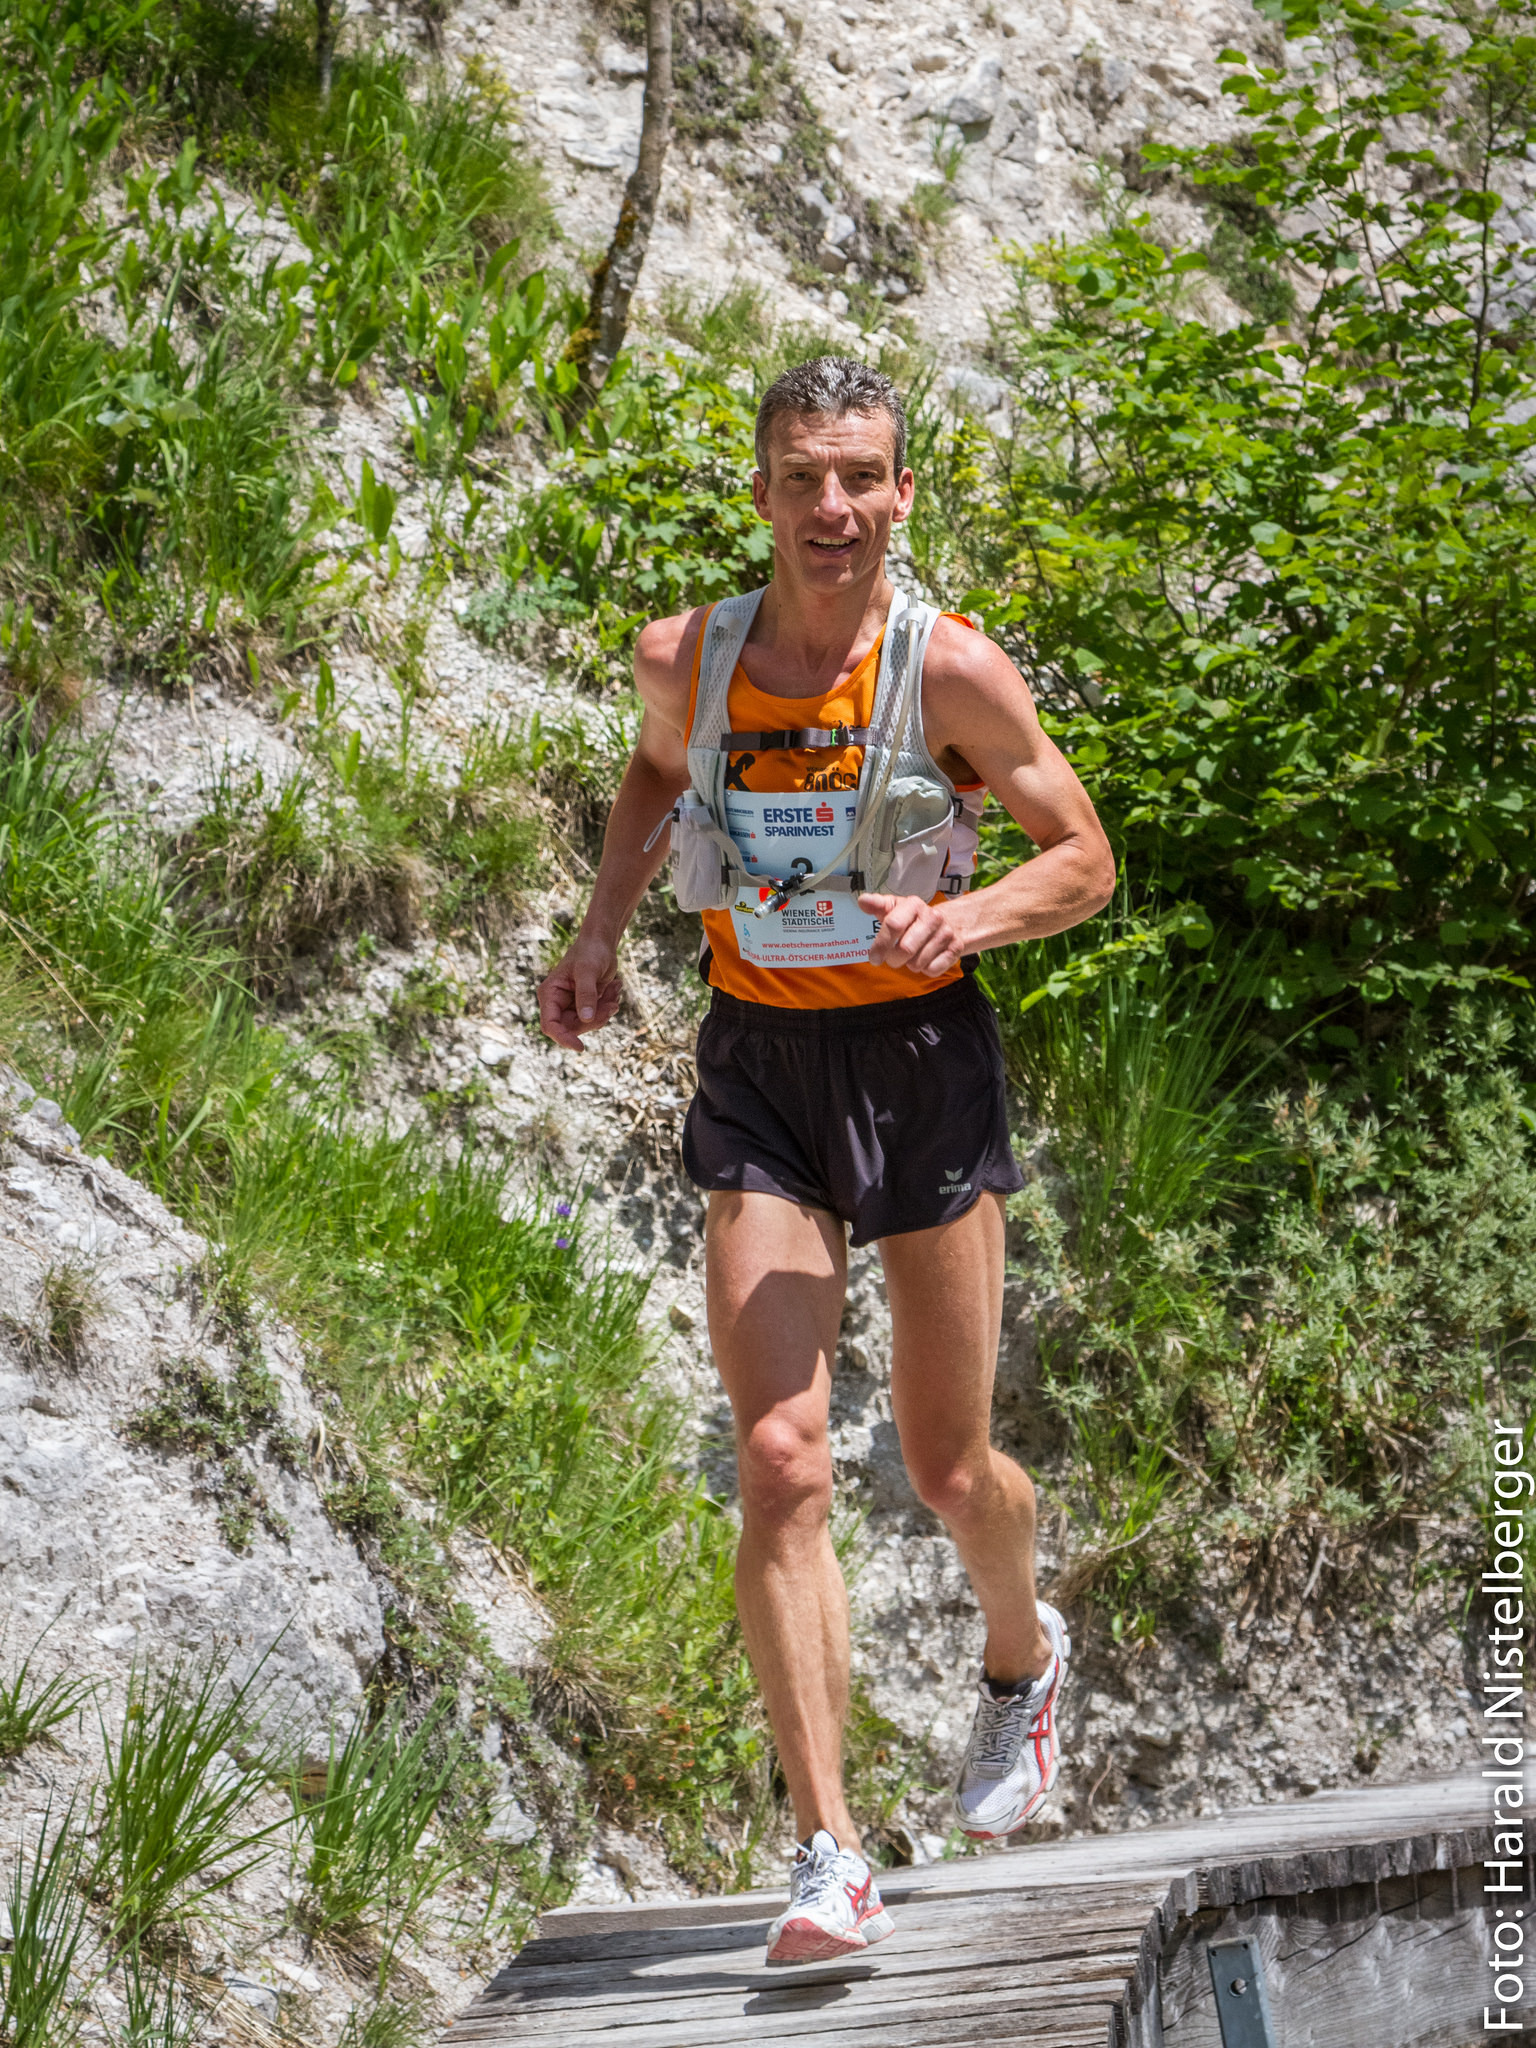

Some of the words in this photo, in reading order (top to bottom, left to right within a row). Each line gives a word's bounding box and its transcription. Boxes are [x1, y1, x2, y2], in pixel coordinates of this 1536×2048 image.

[763, 808, 814, 823] ERSTE
[764, 825, 835, 837] SPARINVEST
[782, 909, 817, 917] WIENER
[782, 917, 835, 926] STÄDTISCHE
[762, 938, 859, 949] www.oetschermarathon.at
[939, 1183, 972, 1194] erima
